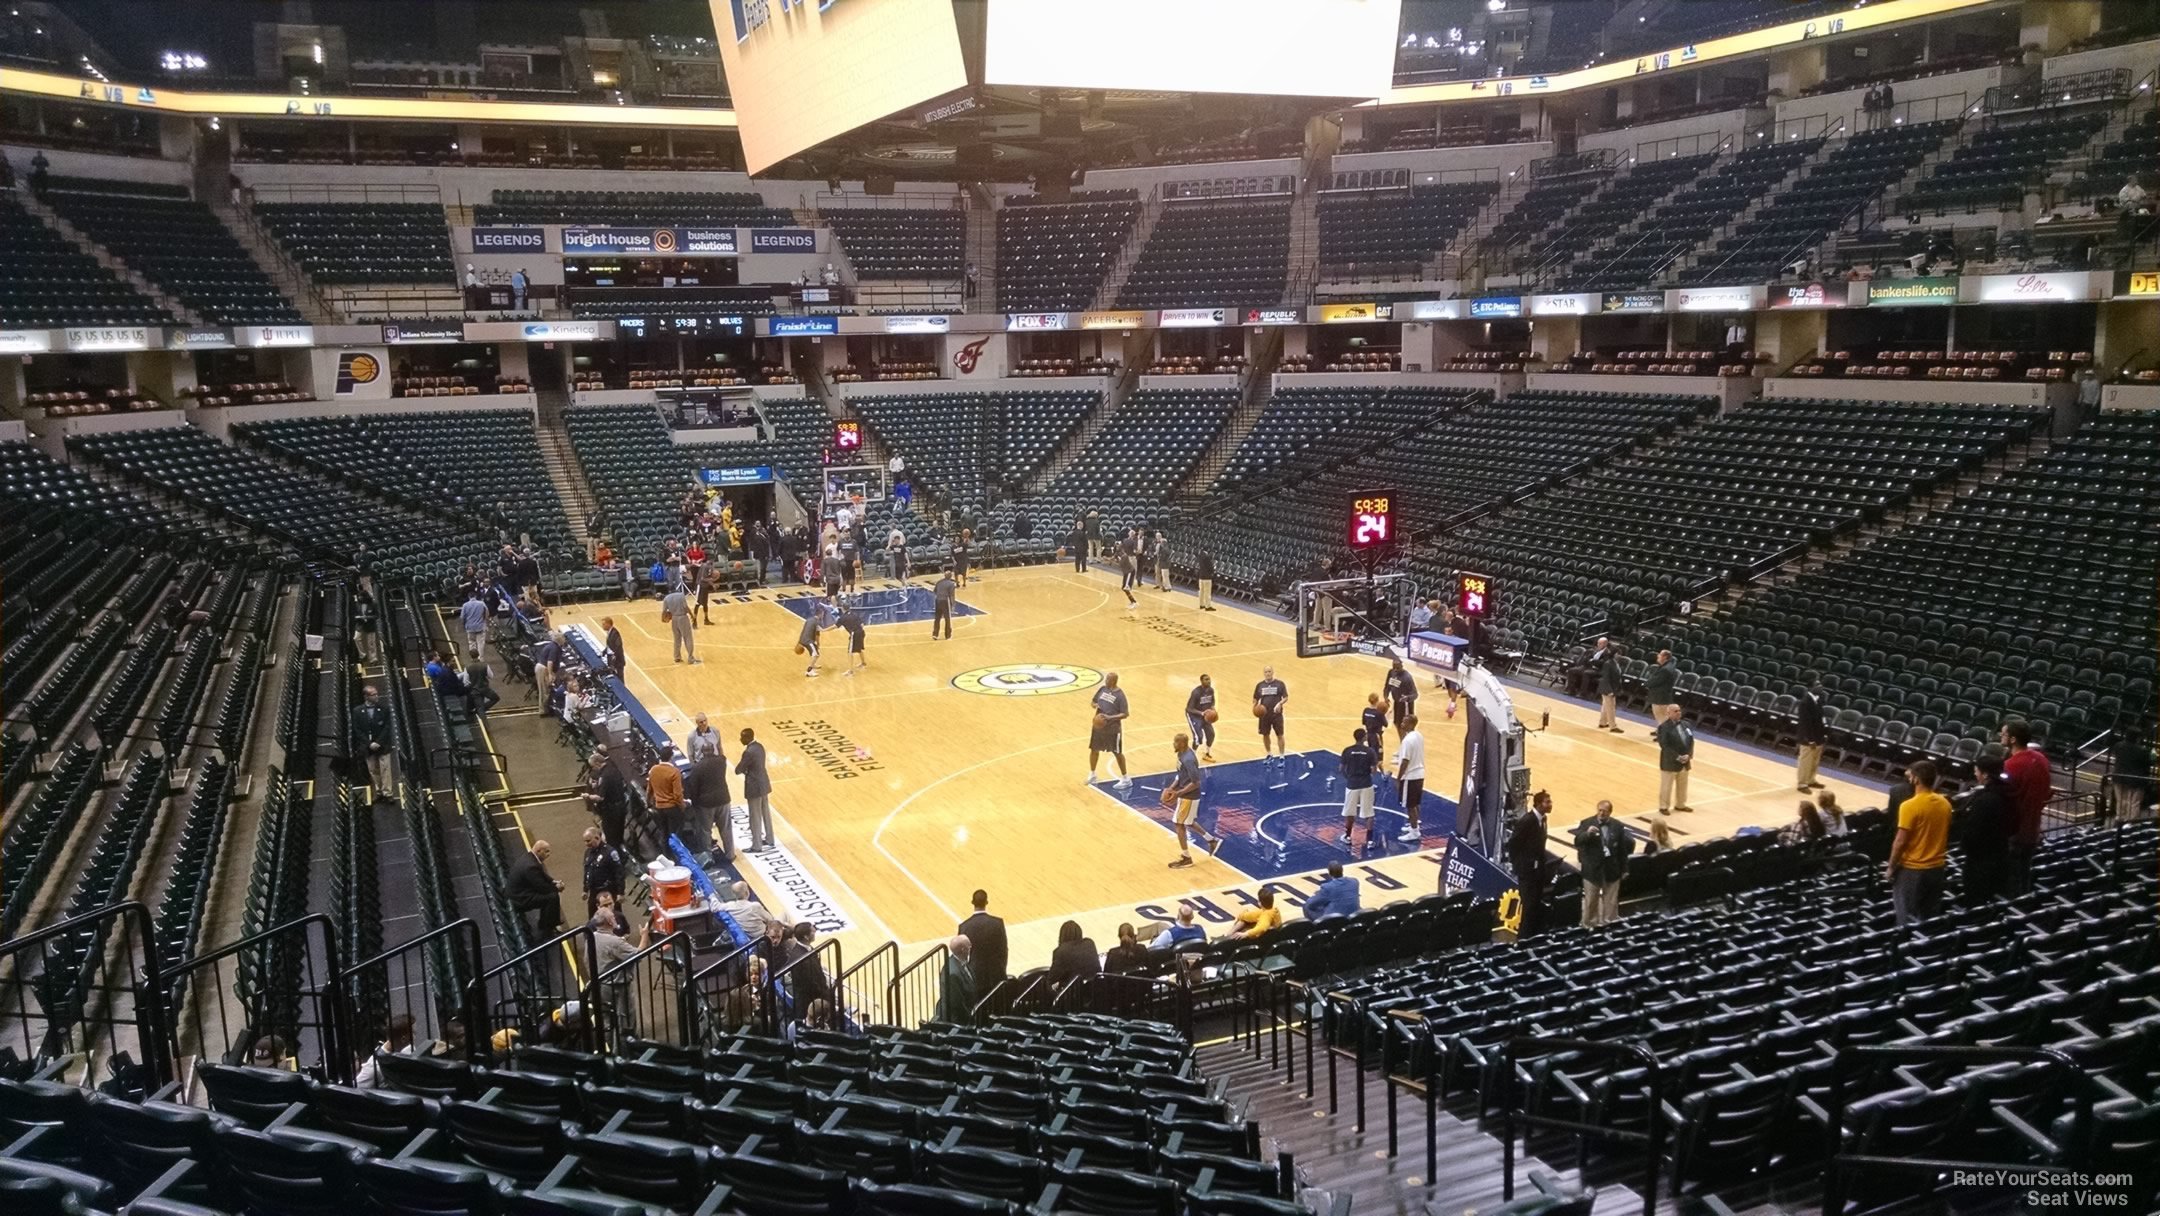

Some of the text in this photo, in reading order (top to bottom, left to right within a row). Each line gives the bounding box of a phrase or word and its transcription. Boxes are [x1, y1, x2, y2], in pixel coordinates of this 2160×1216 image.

[475, 234, 543, 246] LEGENDS
[565, 233, 650, 247] bright house
[688, 231, 731, 241] business
[754, 235, 813, 247] LEGENDS
[689, 241, 734, 251] solutions
[2014, 275, 2052, 294] Lilly
[2131, 274, 2160, 292] DE
[1869, 284, 1956, 298] bankerslife.com
[1552, 299, 1575, 308] STAR
[1196, 312, 1209, 320] WIN
[1376, 306, 1392, 317] CAT
[619, 319, 645, 327] PACERS
[675, 318, 697, 328] 59:38
[719, 317, 742, 325] WOLVES
[776, 321, 833, 331] Finish Line
[1018, 315, 1057, 328] FOX 59
[420, 331, 446, 339] University
[552, 325, 595, 335] Kinetico
[637, 328, 643, 337] 0
[735, 327, 741, 335] 0
[186, 333, 225, 342] LIGHTBOUND
[839, 432, 857, 446] 24
[1354, 498, 1389, 515] 59:38
[1357, 515, 1386, 543] 24
[1467, 592, 1483, 610] 24
[1351, 641, 1374, 652] BANKERS
[1421, 643, 1453, 662] Pacers
[771, 719, 860, 780] BANKERS LIFE
[803, 719, 886, 772] FIELDHOUSE
[1451, 847, 1458, 857] A
[1449, 859, 1475, 879] STATE
[1446, 871, 1470, 889] THAT
